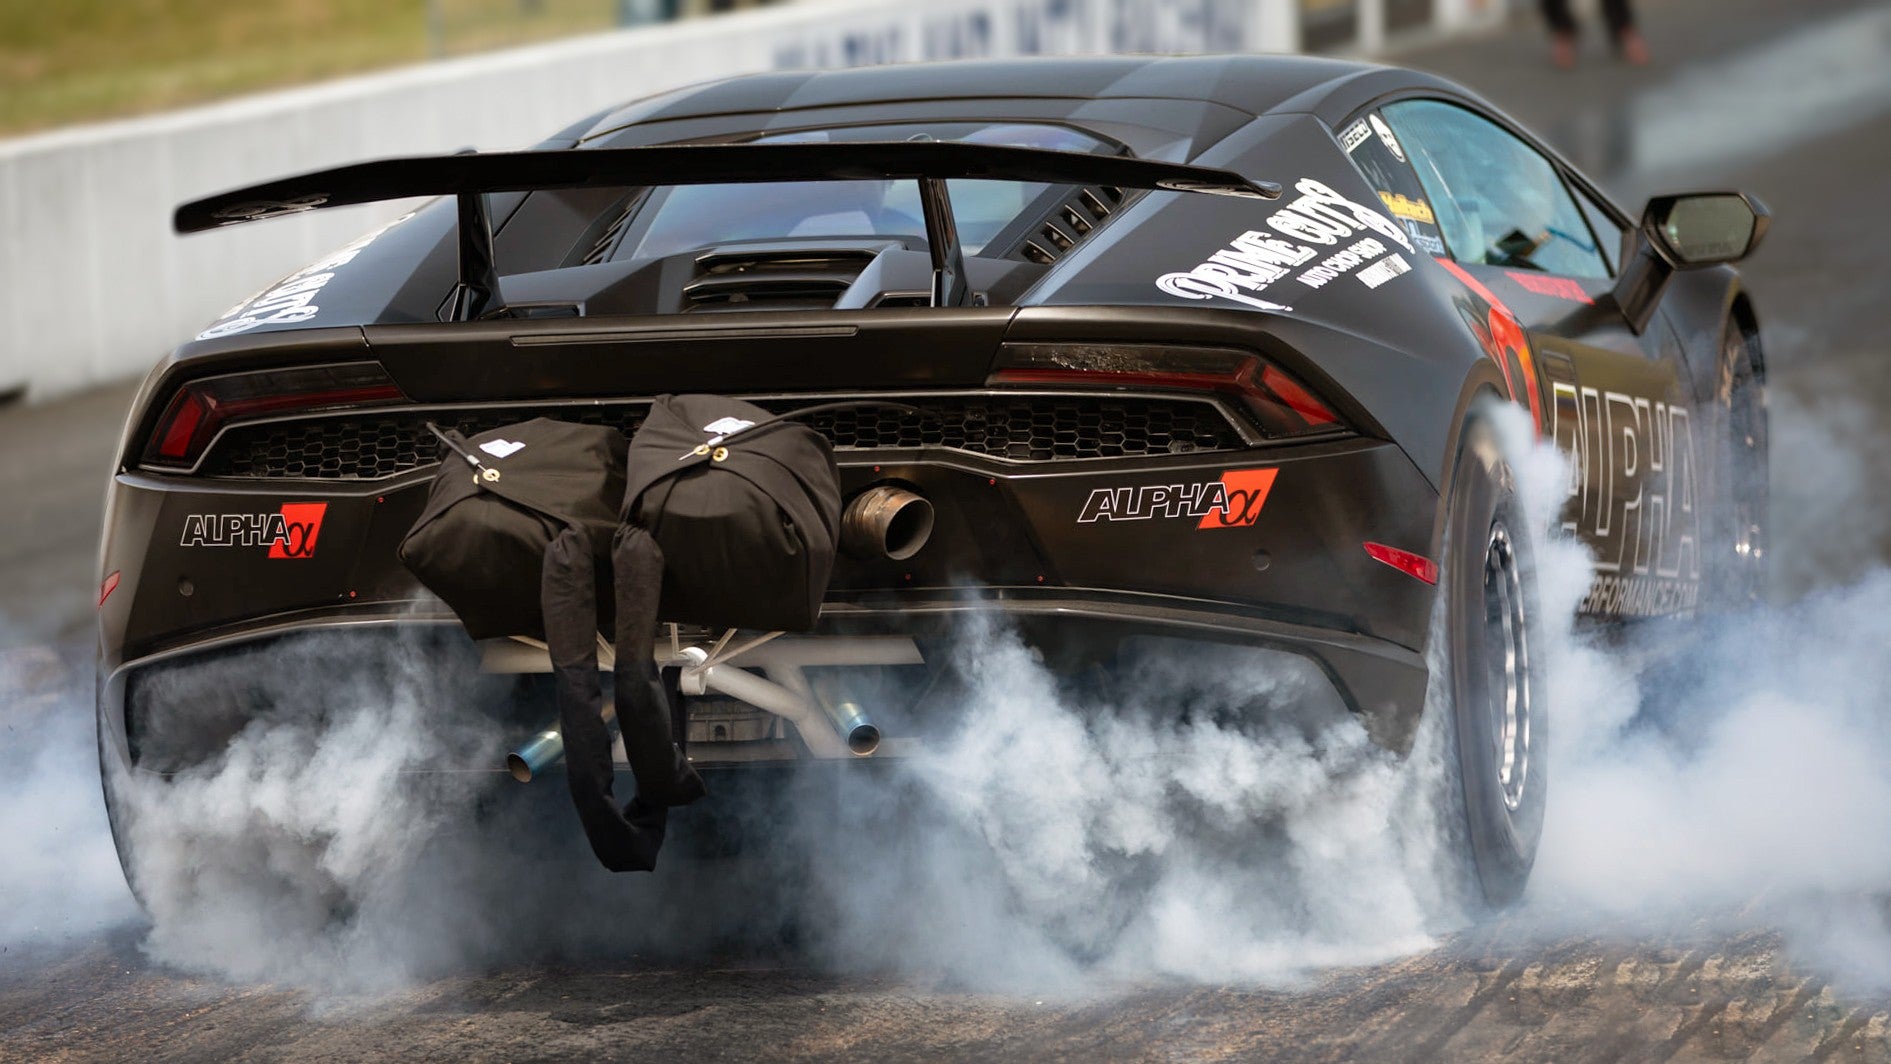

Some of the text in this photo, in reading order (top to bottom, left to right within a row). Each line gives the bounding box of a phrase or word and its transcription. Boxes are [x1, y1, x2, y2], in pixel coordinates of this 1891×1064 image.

[1156, 230, 1318, 311] PRIME
[1266, 178, 1416, 254] CUTS
[1296, 261, 1339, 289] AUTO
[1321, 248, 1364, 274] CHOP
[1347, 238, 1387, 260] SHOP
[1077, 482, 1230, 522] ALPHA
[1552, 382, 1700, 580] ALPHA
[180, 514, 291, 546] ALPHA
